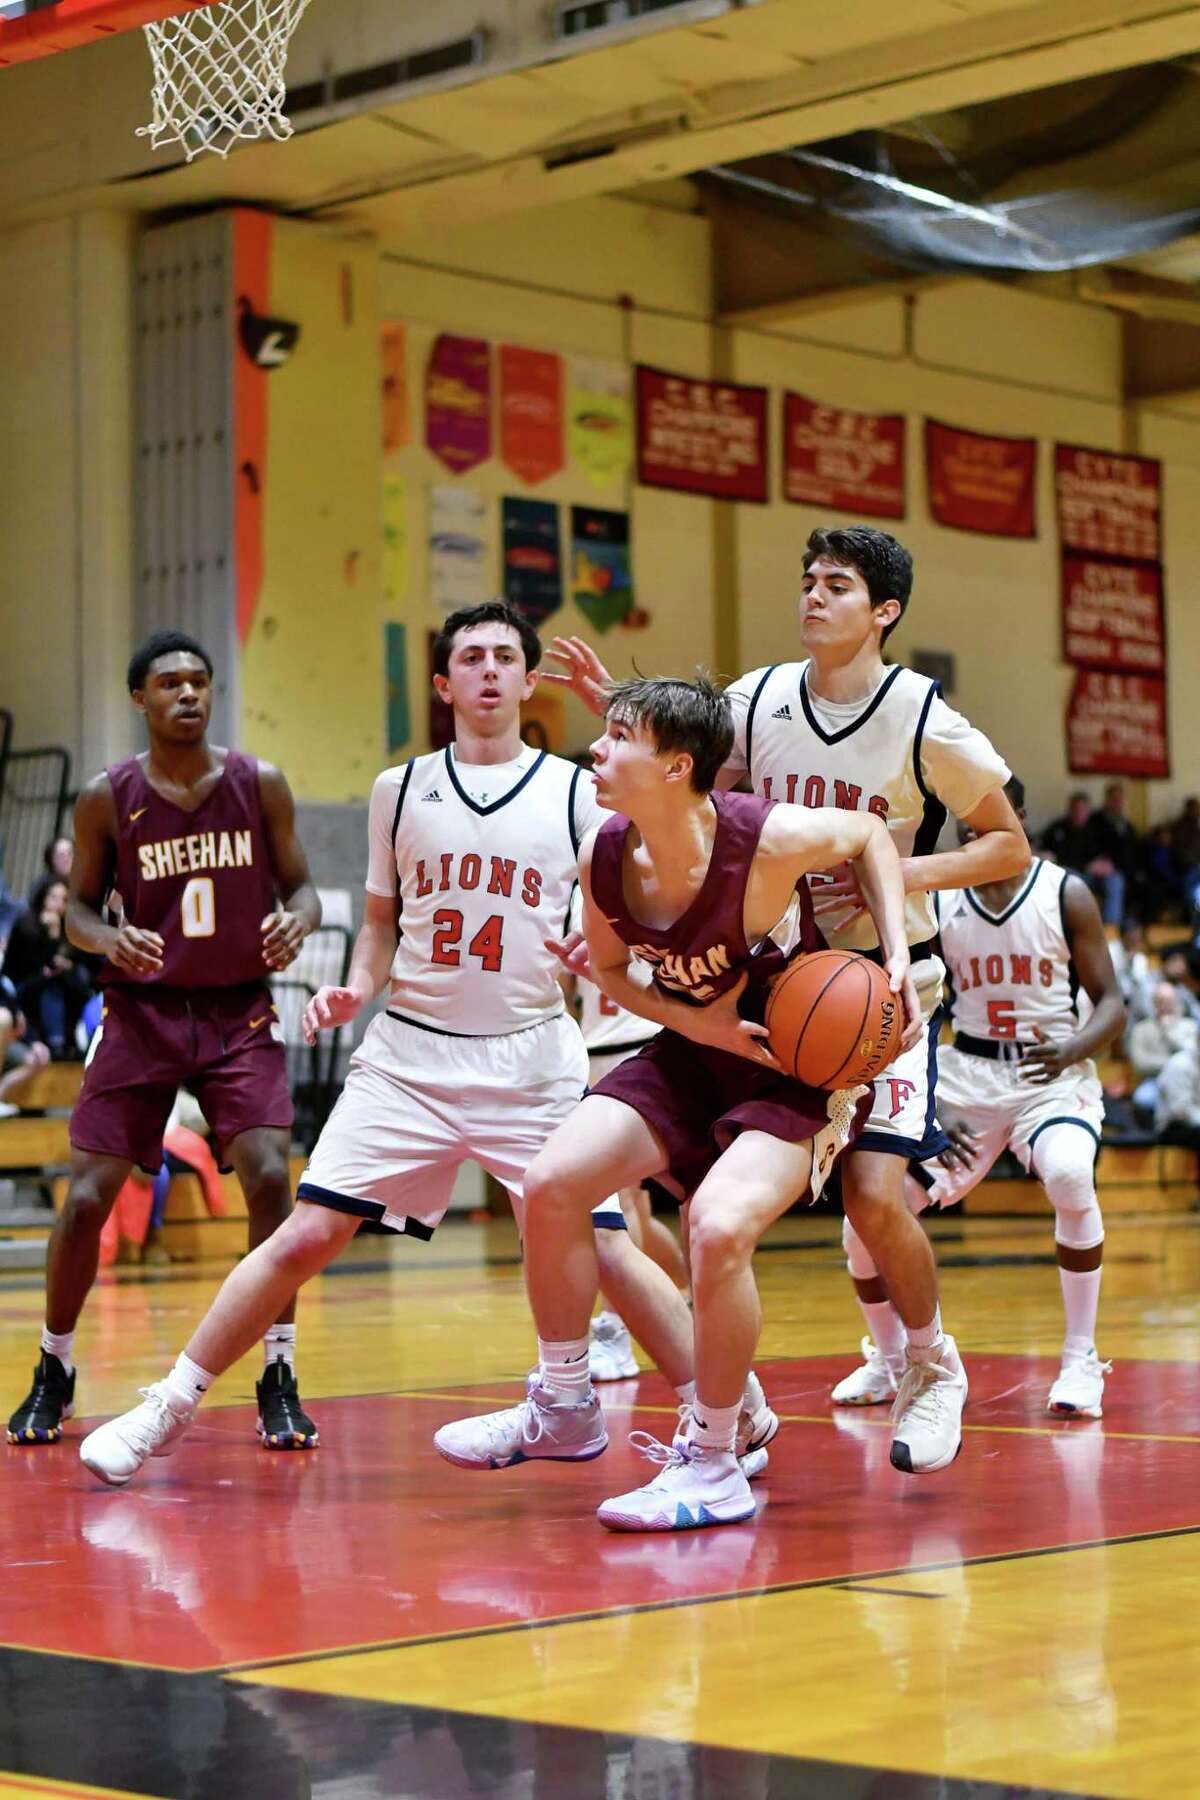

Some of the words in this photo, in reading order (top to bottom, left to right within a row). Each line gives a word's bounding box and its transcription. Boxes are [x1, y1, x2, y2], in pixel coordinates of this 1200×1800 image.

[138, 830, 253, 881] SHEEHAN
[416, 853, 543, 908] LIONS
[181, 877, 216, 938] 0
[431, 909, 504, 972] 24
[958, 954, 1054, 992] LIONS
[987, 1000, 1017, 1039] 5
[886, 1078, 917, 1120] F
